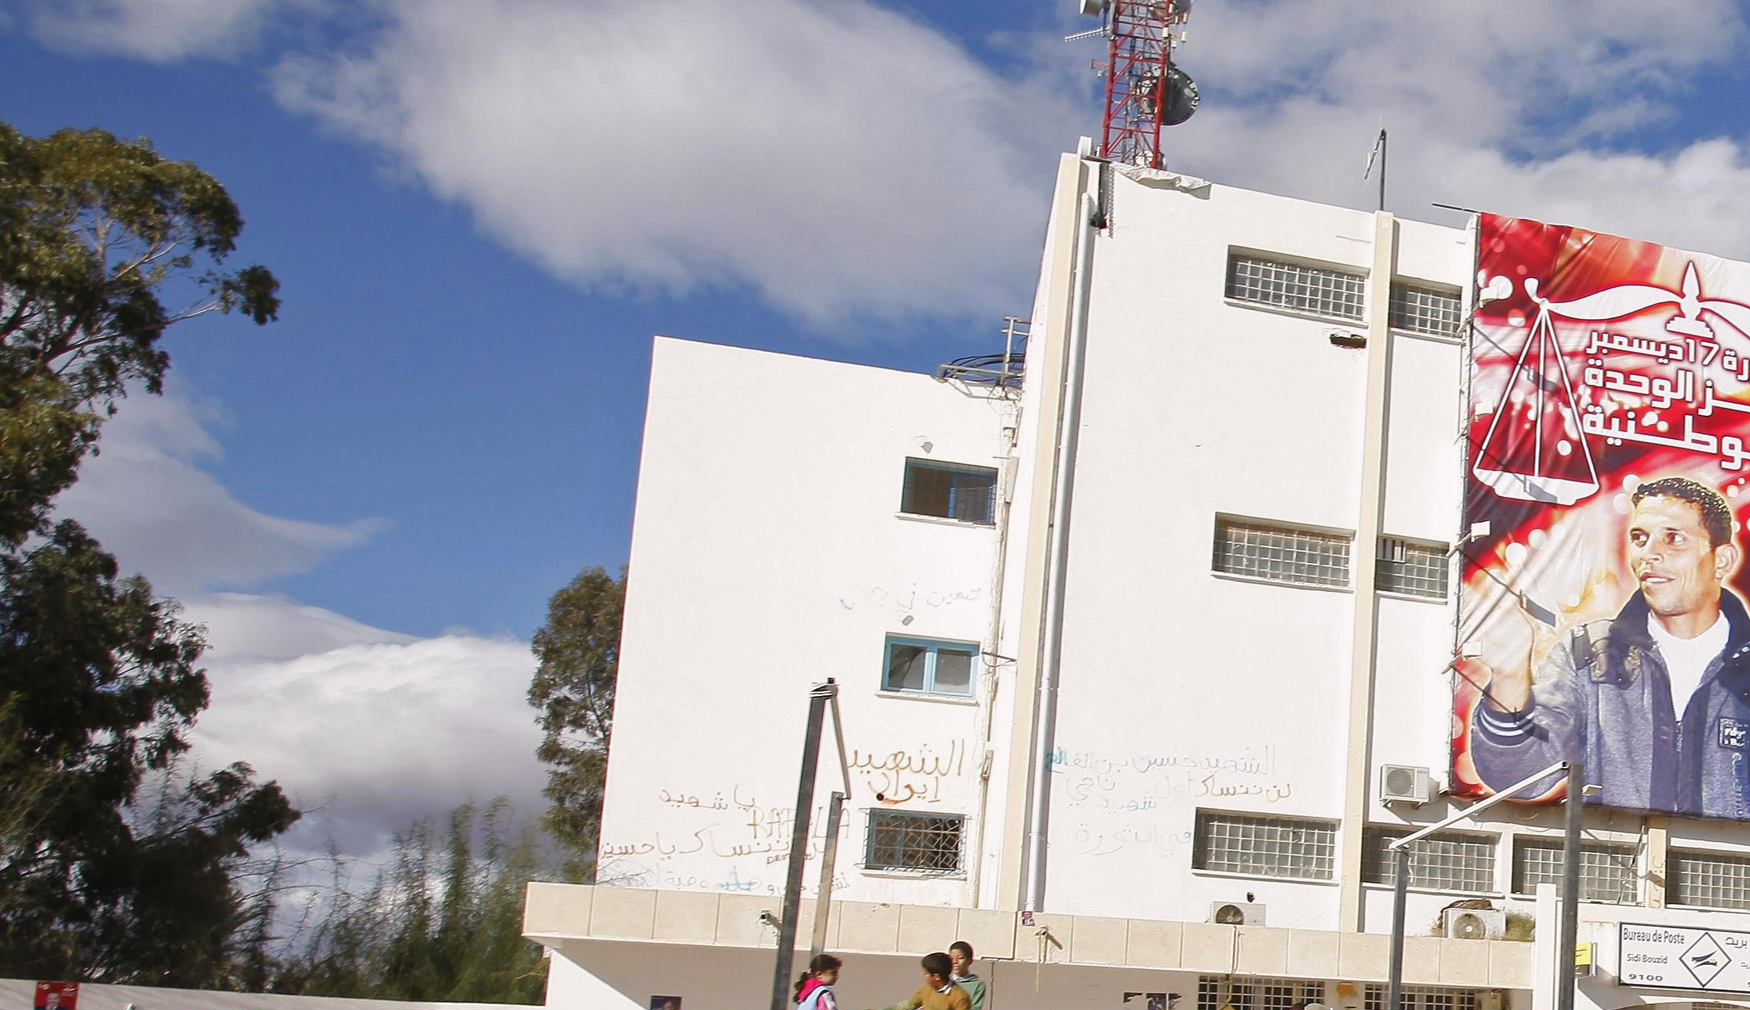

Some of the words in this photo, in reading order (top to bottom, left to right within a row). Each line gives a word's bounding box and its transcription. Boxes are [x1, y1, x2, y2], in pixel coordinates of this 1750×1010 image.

[1585, 331, 1684, 364] ديسمبر
[1684, 337, 1720, 366] 17
[1583, 358, 1693, 409] الوحدة
[1623, 927, 1651, 943] Bureau
[1652, 929, 1662, 944] de
[1664, 931, 1685, 945] Poste
[1725, 936, 1748, 949] بريد
[1626, 953, 1642, 963] Sidi
[1643, 954, 1668, 965] Bouzid
[1628, 973, 1664, 982] 9100
